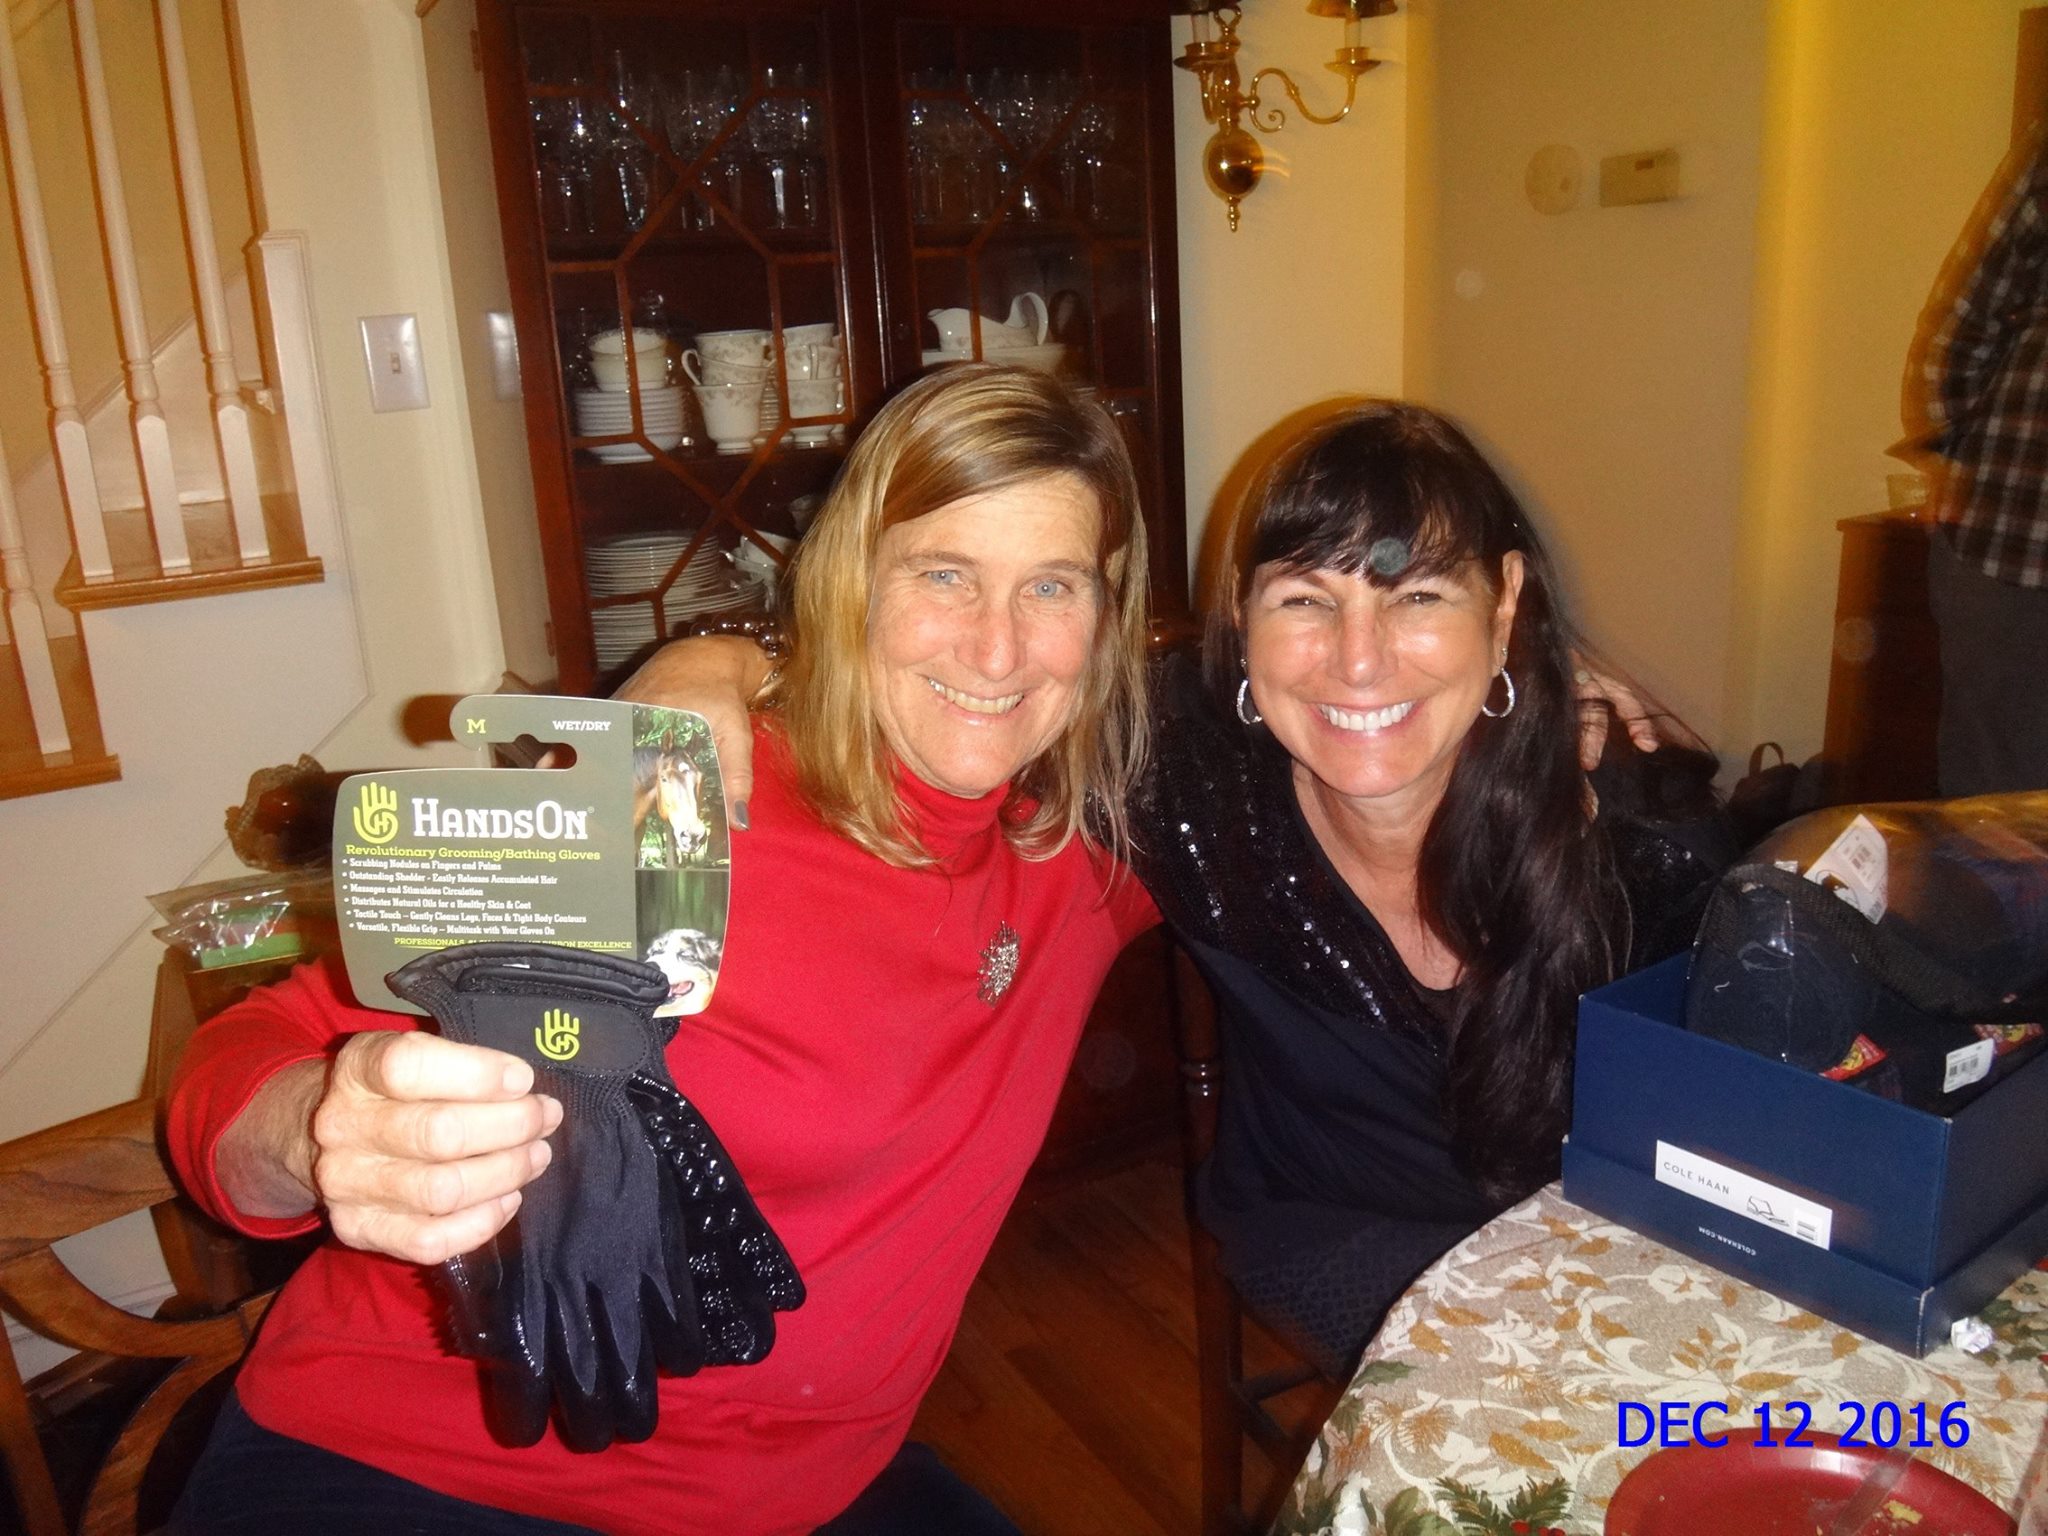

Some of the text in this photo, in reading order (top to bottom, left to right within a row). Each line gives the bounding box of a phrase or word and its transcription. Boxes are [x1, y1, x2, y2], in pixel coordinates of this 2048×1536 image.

[466, 718, 612, 734] M WET/DRY
[345, 844, 601, 862] Revolutionary Grooming/Bathing Gloves
[349, 858, 390, 869] Scrubbing
[431, 860, 460, 871] Fingers
[462, 861, 477, 870] and
[478, 862, 502, 871] Palms
[349, 871, 394, 882] Outstanding
[395, 872, 426, 882] Shedder
[432, 873, 456, 884] Easily
[491, 874, 540, 885] Accumulated
[540, 875, 558, 884] Hair
[350, 883, 484, 896] Massages and Stimulates Circulation
[351, 896, 392, 906] Distributes
[392, 898, 421, 907] Natural
[422, 898, 437, 908] Oils
[438, 899, 449, 908] for
[456, 900, 486, 911] Healthy
[487, 900, 505, 909] Skin
[506, 901, 514, 909] &
[514, 901, 532, 910] Coat
[353, 908, 378, 919] Tactile
[379, 909, 401, 919] Touch
[410, 911, 434, 922] Gently
[434, 911, 459, 921] Cleans
[481, 913, 503, 922] Faces
[504, 913, 512, 922] &
[512, 913, 533, 924] Tight
[534, 914, 552, 924] Body
[553, 914, 587, 923] Contours
[391, 923, 421, 933] Flexible
[421, 924, 438, 935] Grip
[446, 925, 482, 935] Multitask
[483, 925, 500, 935] with
[501, 926, 518, 935] Your
[519, 926, 544, 935] Gloves
[544, 926, 555, 935] On
[577, 940, 632, 949] EXCELLENCE
[1663, 1161, 1730, 1195] COLE HAAN
[1698, 1226, 1757, 1256] COLEHAAN.COM
